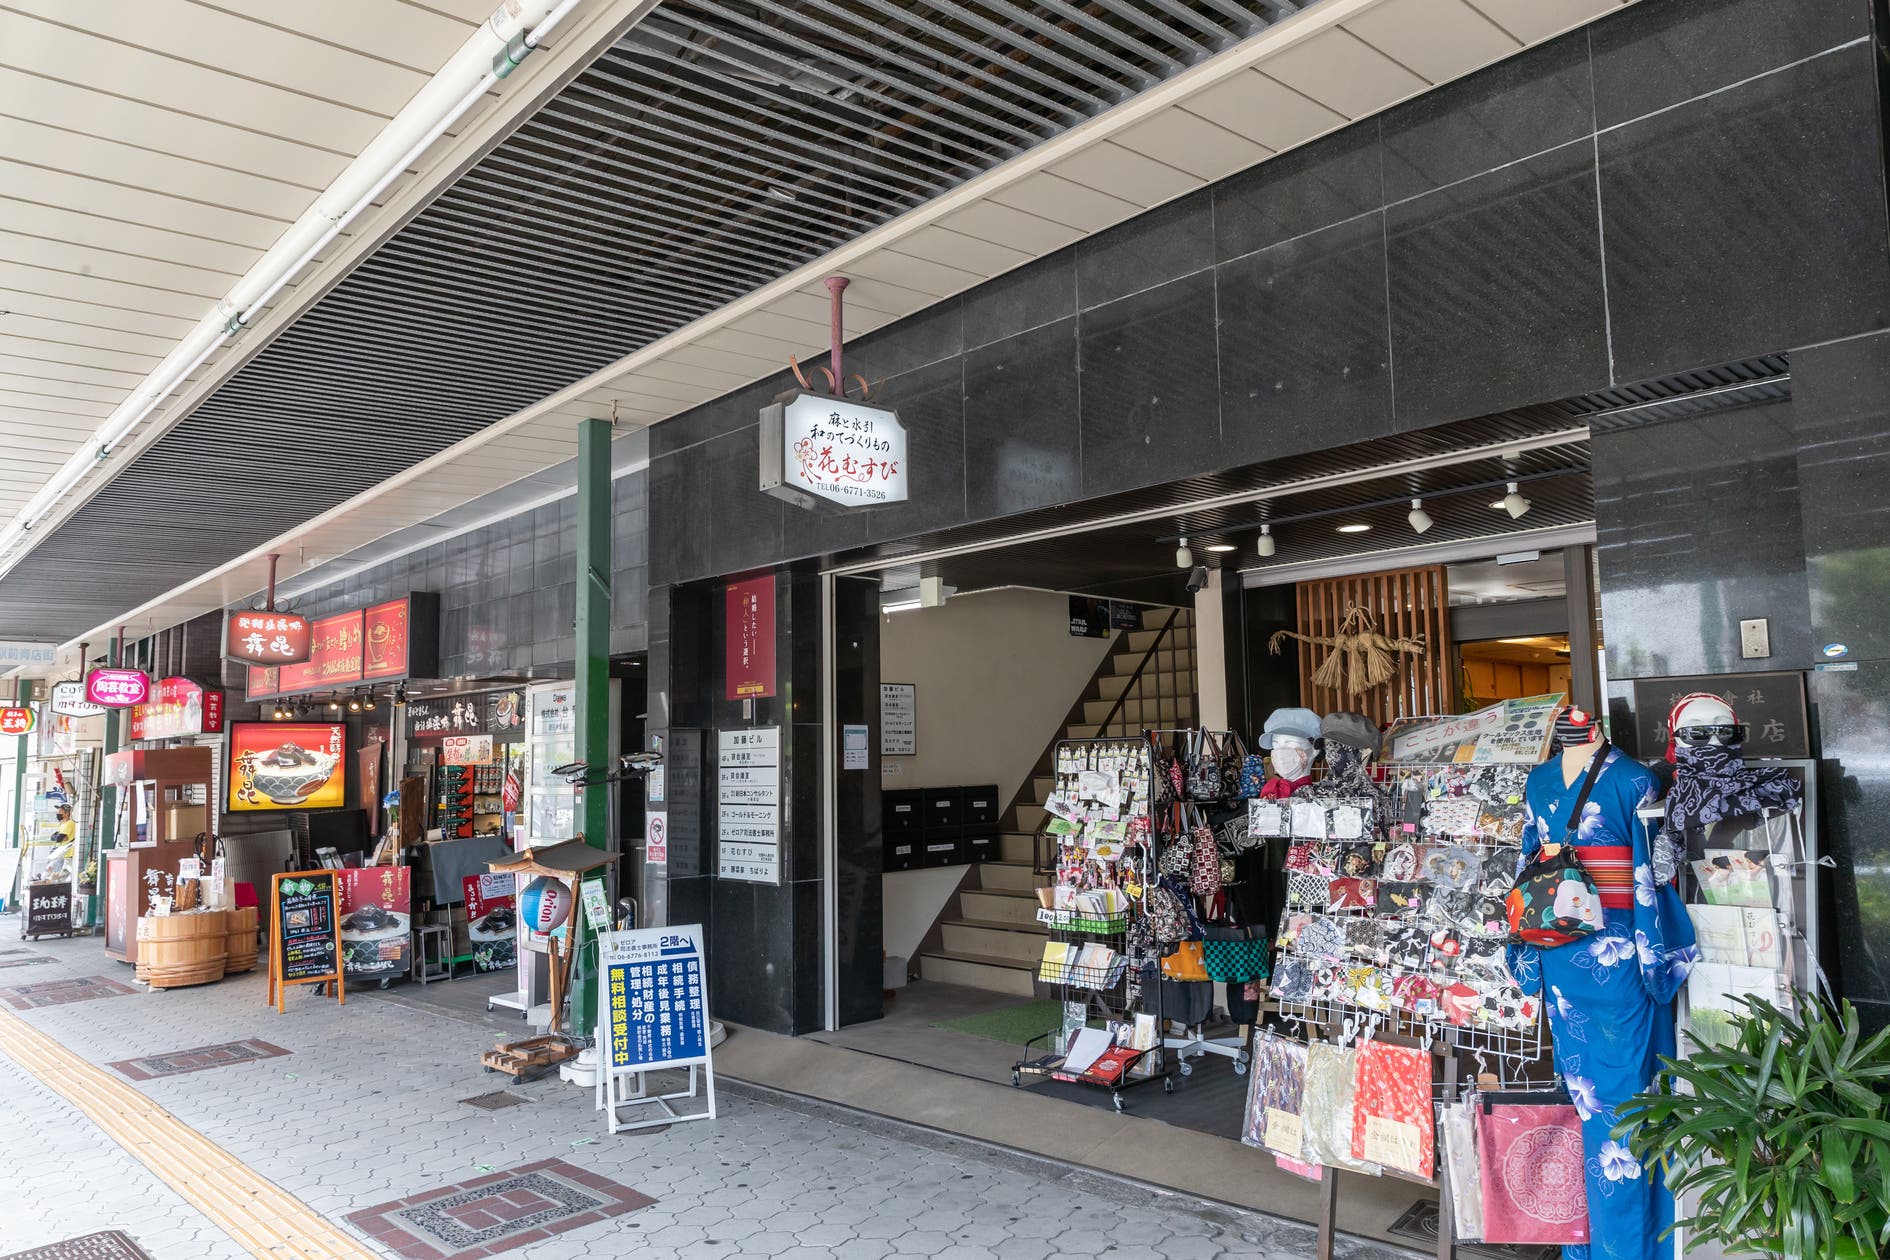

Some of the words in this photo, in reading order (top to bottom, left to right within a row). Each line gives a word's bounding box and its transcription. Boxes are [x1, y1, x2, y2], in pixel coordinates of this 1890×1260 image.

[811, 424, 890, 452] 和のてづくりもの
[829, 412, 874, 433] 麻と水引
[818, 446, 899, 481] 花むすび
[1406, 712, 1497, 748] ここが違う
[540, 889, 558, 923] Orion
[660, 935, 689, 948] 2階へ
[630, 967, 643, 1021] 管理・処分
[641, 965, 655, 1023] 相続財産の
[657, 964, 672, 1037] 成年後見業務
[672, 963, 686, 1012] 相続手続
[687, 961, 701, 1010] 債務整理
[610, 968, 629, 1065] 無料相談受付中
